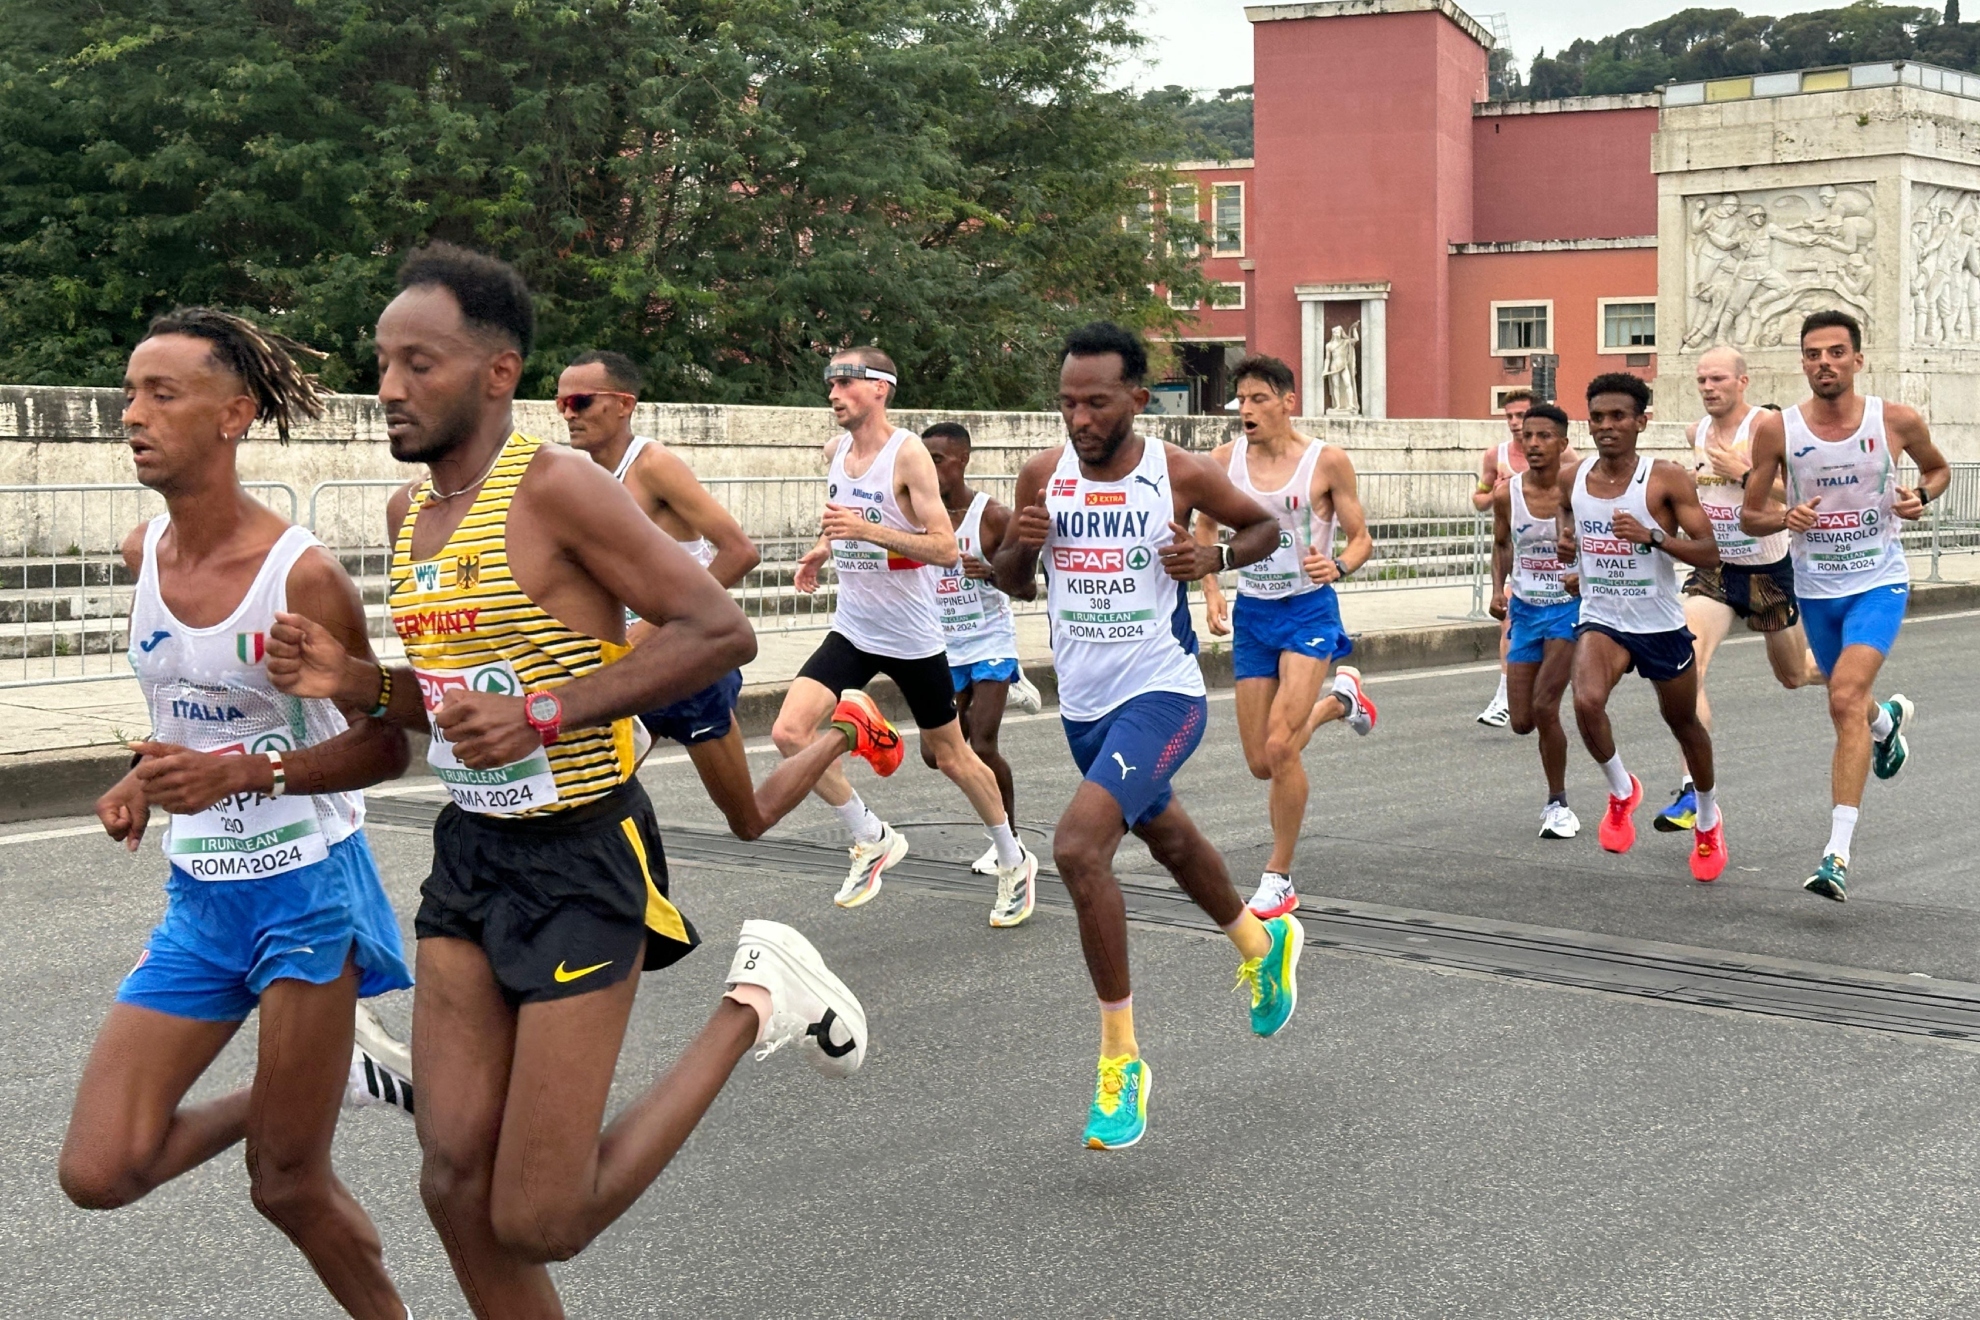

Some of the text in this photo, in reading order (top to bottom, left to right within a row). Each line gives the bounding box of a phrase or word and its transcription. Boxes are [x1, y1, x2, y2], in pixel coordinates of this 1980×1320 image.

[1817, 475, 1859, 487] ITALIA
[852, 488, 873, 500] Allianz
[1057, 511, 1149, 538] NORWAY
[1806, 527, 1878, 543] SELVAROLO
[1583, 539, 1632, 554] SPAR
[1731, 547, 1752, 555] 2024
[1835, 544, 1851, 553] 296
[857, 562, 879, 570] 2024
[1055, 551, 1122, 569] SPAR
[1596, 559, 1637, 569] AYALE
[1818, 558, 1875, 571] ROMA 2024
[1253, 564, 1269, 572] 295
[1608, 570, 1624, 578] 280
[937, 580, 958, 592] AR
[1067, 577, 1136, 595] KIBRAB
[1245, 580, 1292, 591] ROMA 2024
[1592, 586, 1647, 596] ROMA 2024
[1090, 598, 1111, 610] 308
[1531, 597, 1554, 605] ROMA
[1077, 613, 1097, 622] RUN
[393, 607, 482, 641] ERMANY
[957, 622, 977, 632] 2024
[1069, 624, 1144, 638] ROMA 2024
[172, 699, 247, 721] ITALIA
[448, 770, 469, 783] RUN
[456, 784, 533, 807] OMA 2024
[221, 817, 244, 834] 290
[192, 845, 303, 876] ROMA 2024
